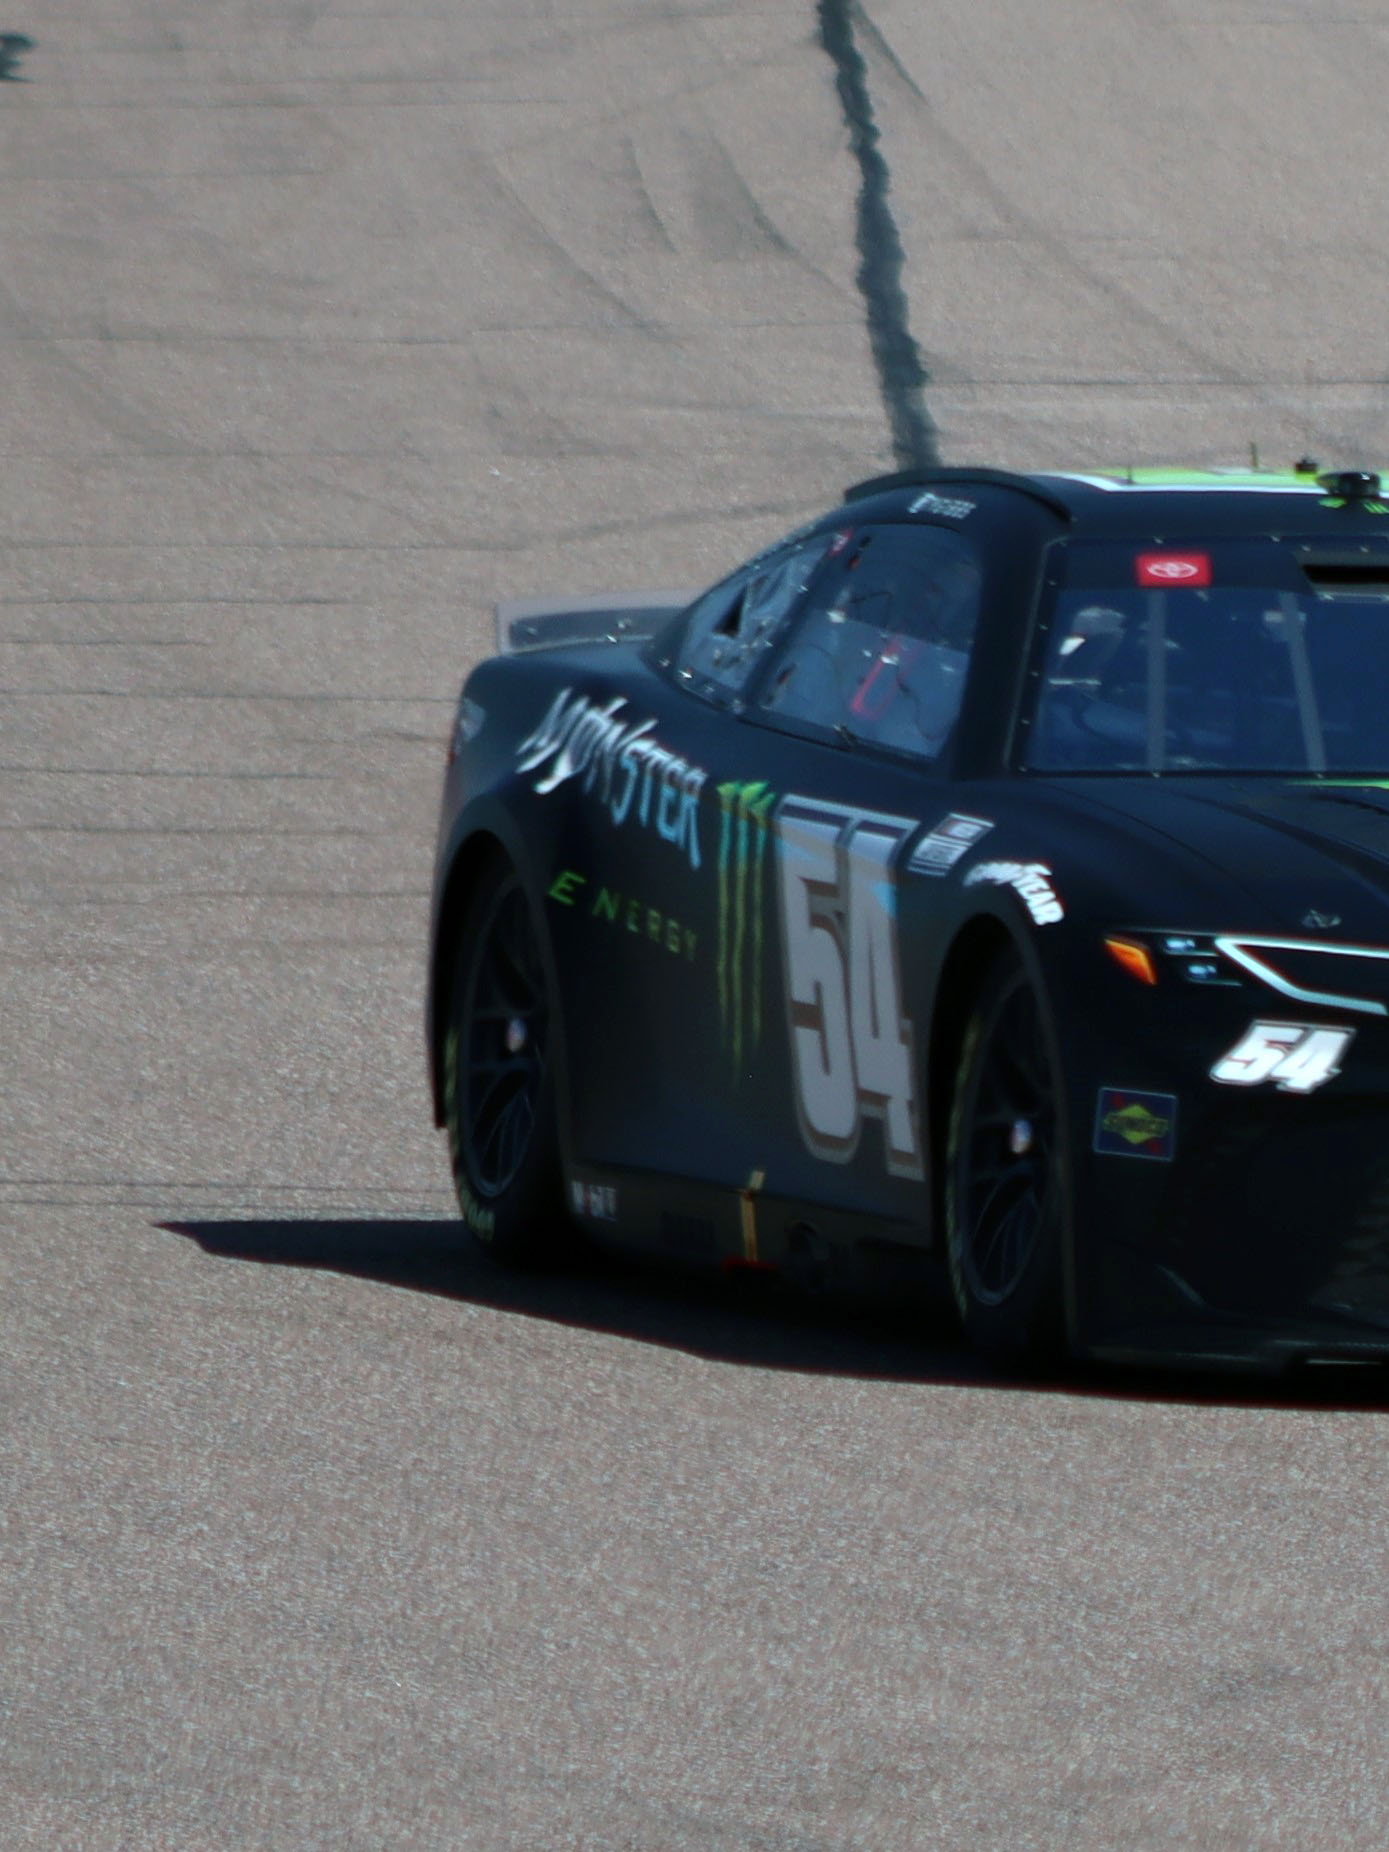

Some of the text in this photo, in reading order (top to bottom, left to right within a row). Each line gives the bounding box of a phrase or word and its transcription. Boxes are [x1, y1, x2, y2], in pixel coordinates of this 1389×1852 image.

[514, 685, 708, 869] MONSTER
[547, 870, 698, 961] ENERGY
[776, 795, 924, 1181] 54
[1209, 1019, 1356, 1093] 54
